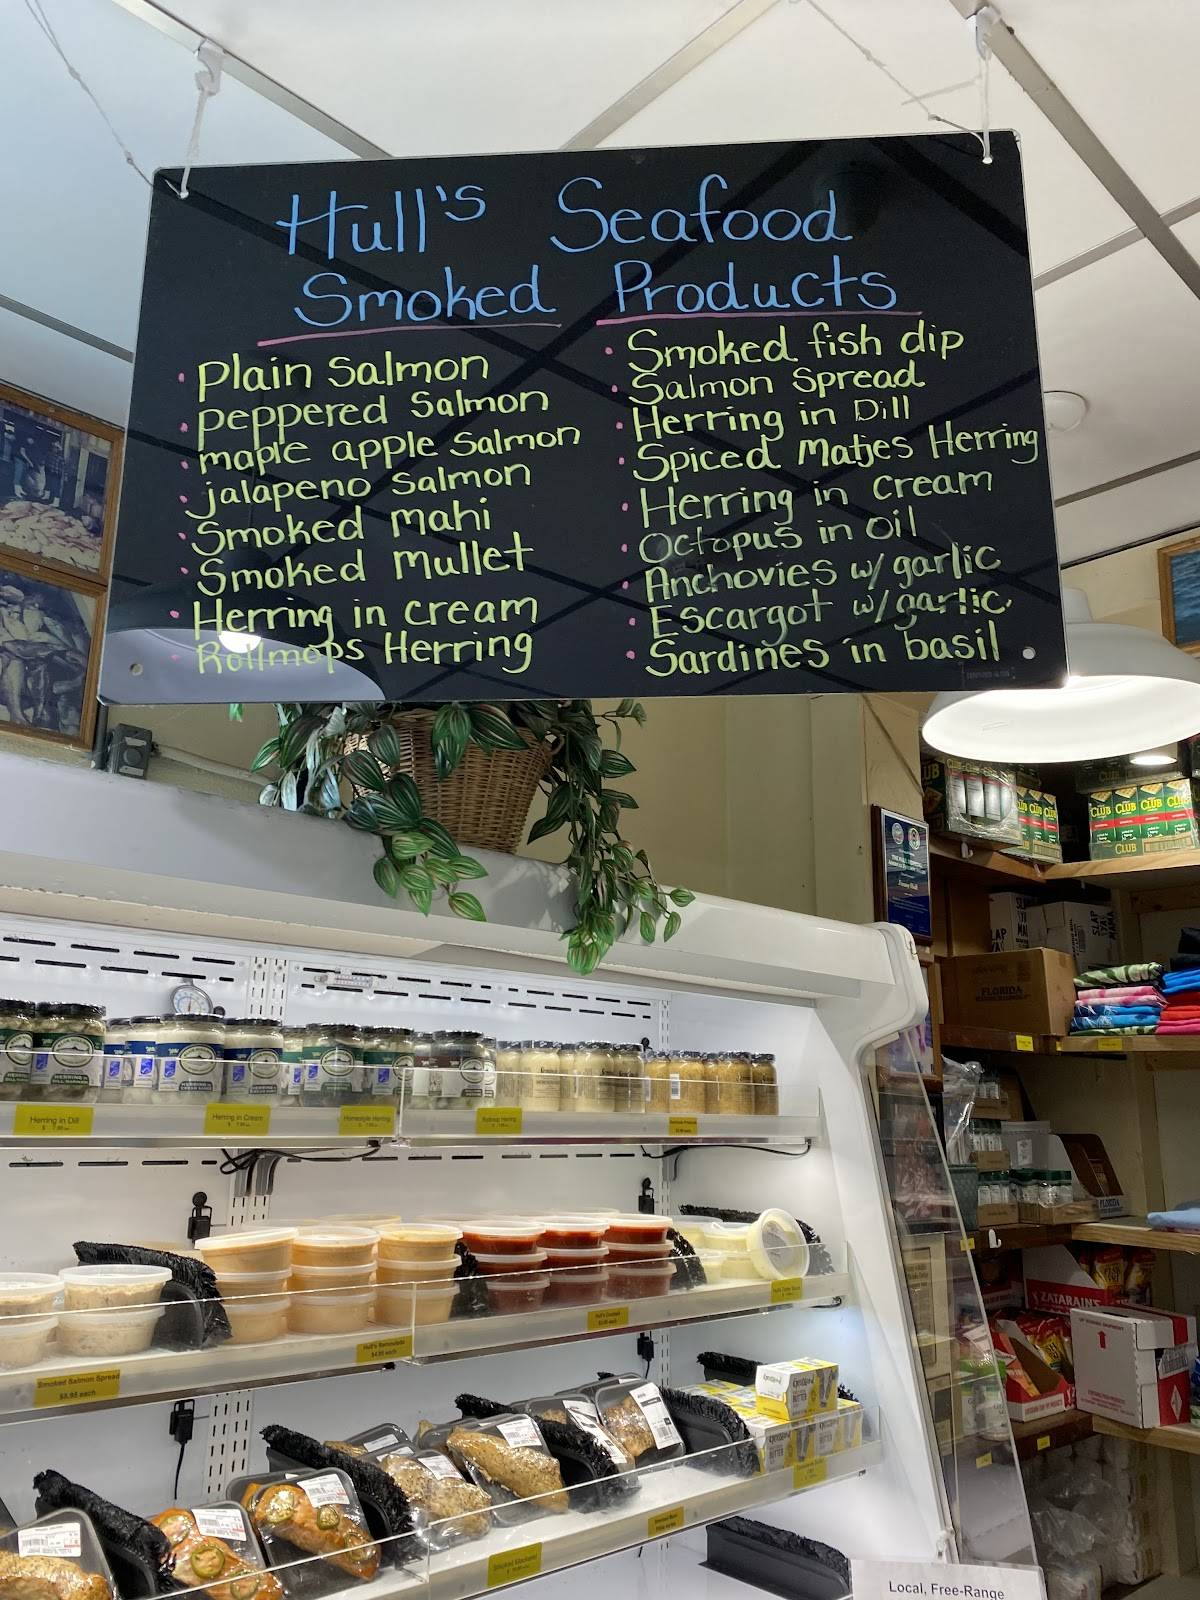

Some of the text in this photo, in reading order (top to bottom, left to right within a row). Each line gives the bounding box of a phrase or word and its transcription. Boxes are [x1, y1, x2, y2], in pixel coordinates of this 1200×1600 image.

[276, 173, 853, 260] Hull's Seafood
[294, 255, 897, 327] Smoked Products
[628, 319, 965, 374] Smoked fish dip
[629, 373, 774, 405] Salmon
[633, 394, 911, 442] Herring in Dill
[331, 430, 440, 470] apple
[633, 434, 782, 483] Spiced
[928, 420, 1040, 465] Herring
[639, 484, 794, 529] Herring
[813, 480, 849, 507] in
[191, 505, 365, 556] Smoked
[638, 505, 917, 565] Octopus in oil
[197, 548, 367, 597] Smoked
[645, 541, 1001, 603] Anchovies w/ garlic
[193, 598, 335, 642] Herring
[353, 598, 388, 630] in
[649, 588, 834, 647] Escargot
[853, 589, 890, 624] w/
[196, 629, 534, 675] Rollmops Herring
[645, 619, 1001, 678] Sardines in basil
[1090, 805, 1112, 818] CLUB
[1115, 802, 1137, 814] CLUB
[1140, 798, 1163, 811] CLUB
[1115, 843, 1137, 855] CLUB
[981, 985, 1023, 997] FLORIDA
[30, 1116, 58, 1125] Herring
[212, 1113, 235, 1122] Herring
[37, 1373, 120, 1389] Smoked Salmon Spread
[889, 1580, 1006, 1600] Local, Free-Range
